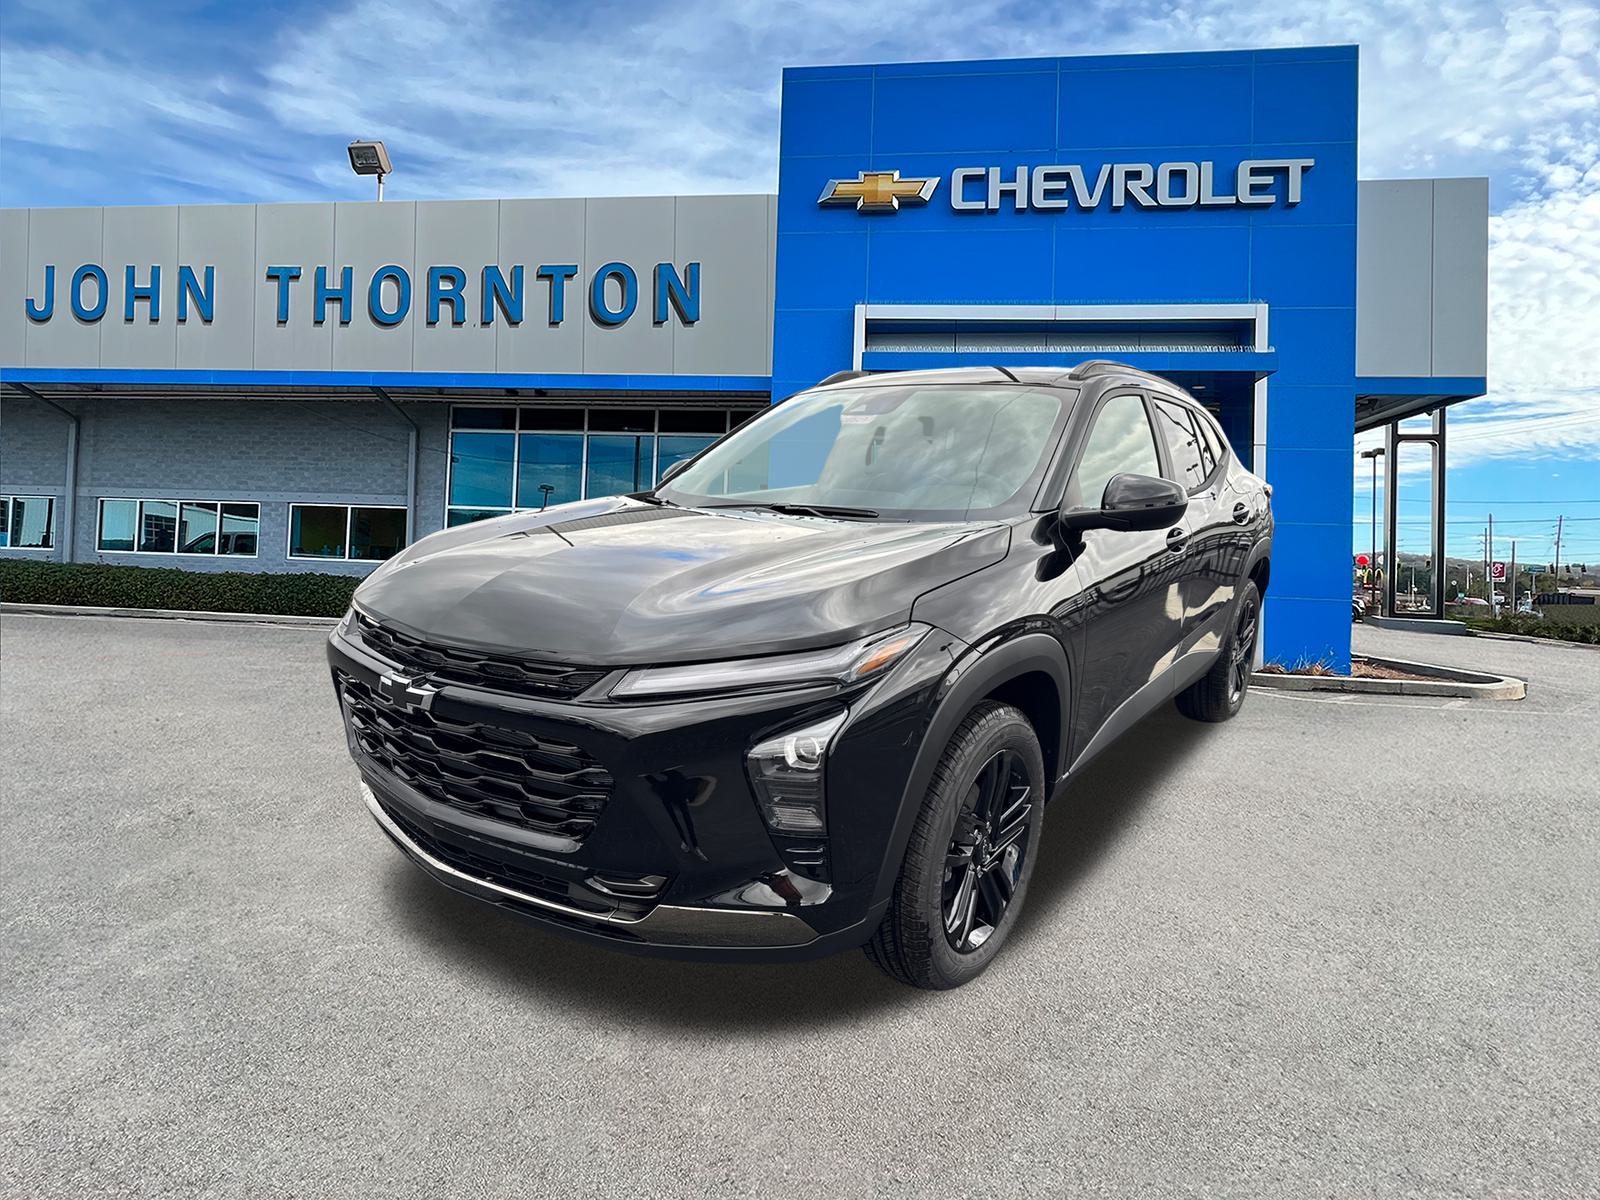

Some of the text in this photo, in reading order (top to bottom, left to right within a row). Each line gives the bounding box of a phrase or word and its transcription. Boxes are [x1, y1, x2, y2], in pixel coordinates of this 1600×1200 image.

[950, 158, 1315, 210] CHEVROLET
[25, 261, 702, 327] JOHN THORNTON
